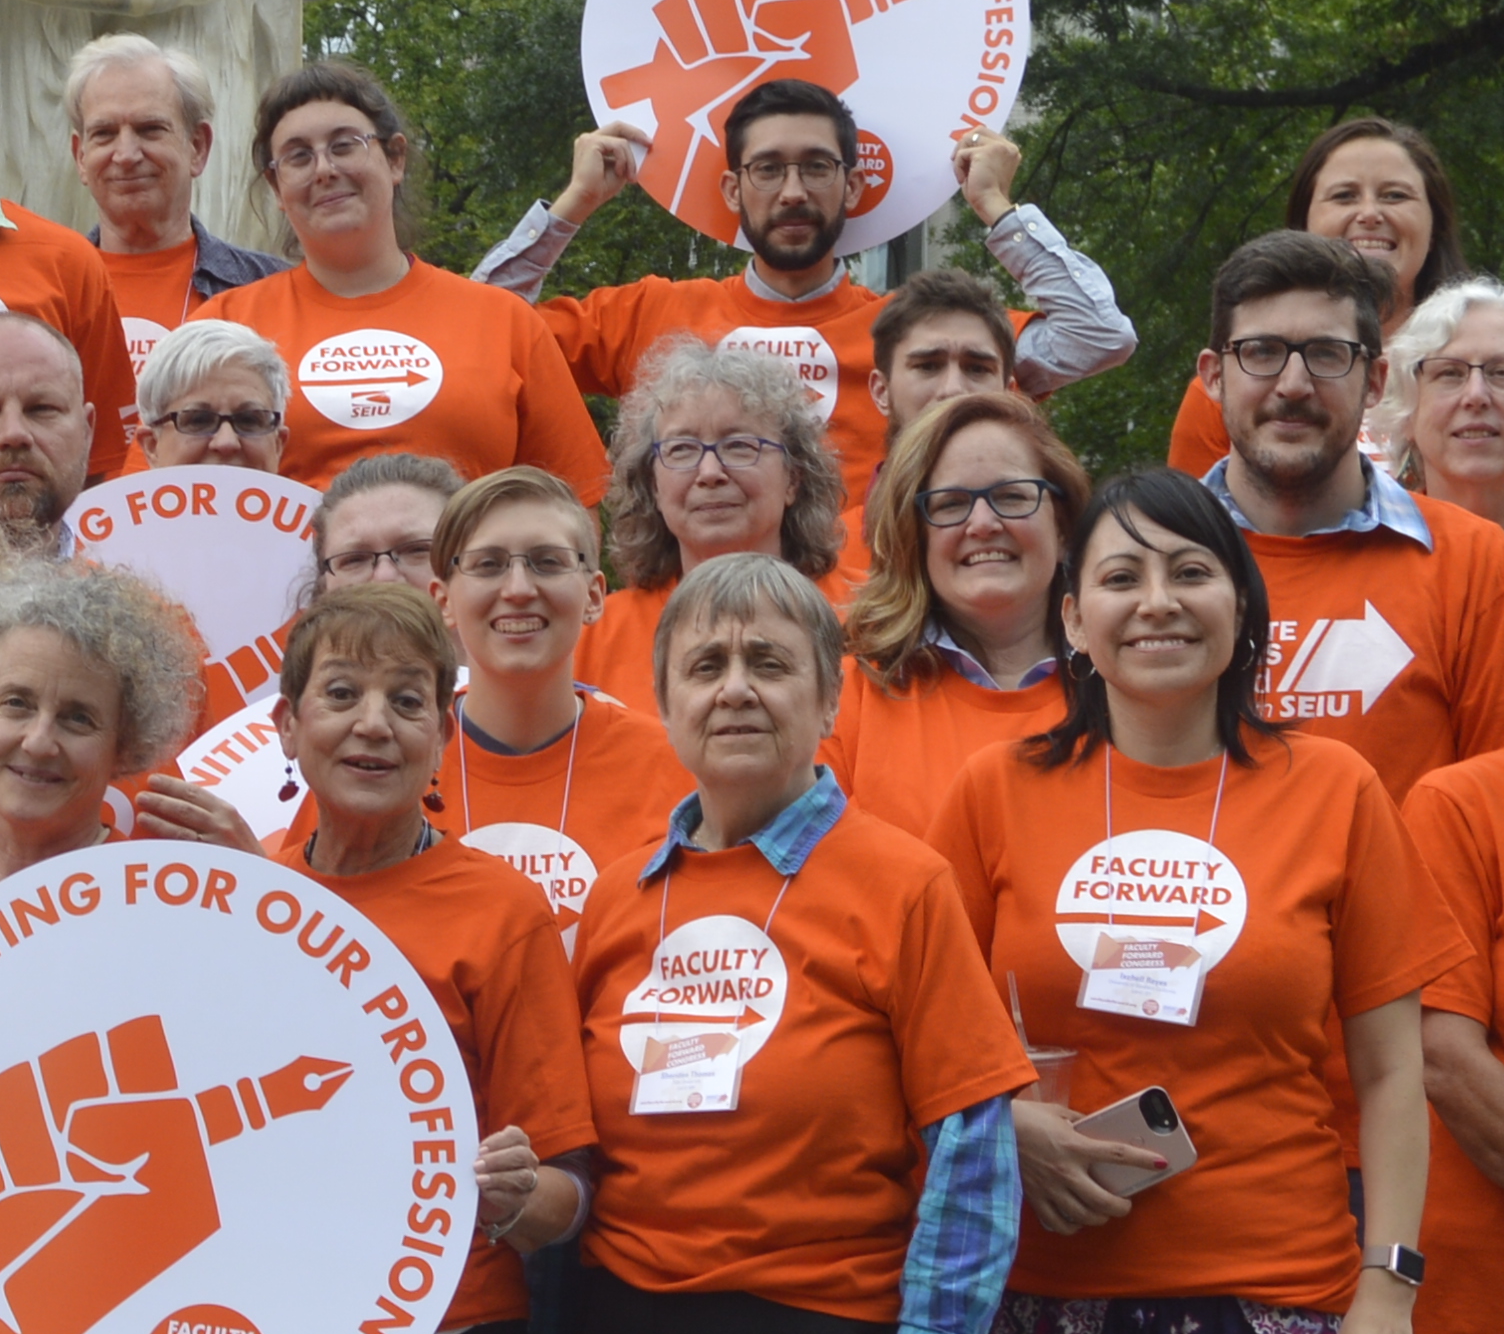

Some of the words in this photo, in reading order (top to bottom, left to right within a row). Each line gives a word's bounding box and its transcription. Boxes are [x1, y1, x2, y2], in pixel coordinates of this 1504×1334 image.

[320, 345, 418, 358] FACULTY
[311, 357, 430, 372] FORWARD
[350, 406, 390, 417] SEIU
[126, 483, 218, 525] FOR
[1279, 694, 1350, 718] SEIU
[1090, 856, 1223, 880] FACULTY
[1073, 881, 1232, 905] FORWARD
[124, 862, 237, 915] FOR
[255, 890, 371, 990] OUR
[660, 948, 769, 980] FACULTY
[640, 977, 774, 1005] FORWARD
